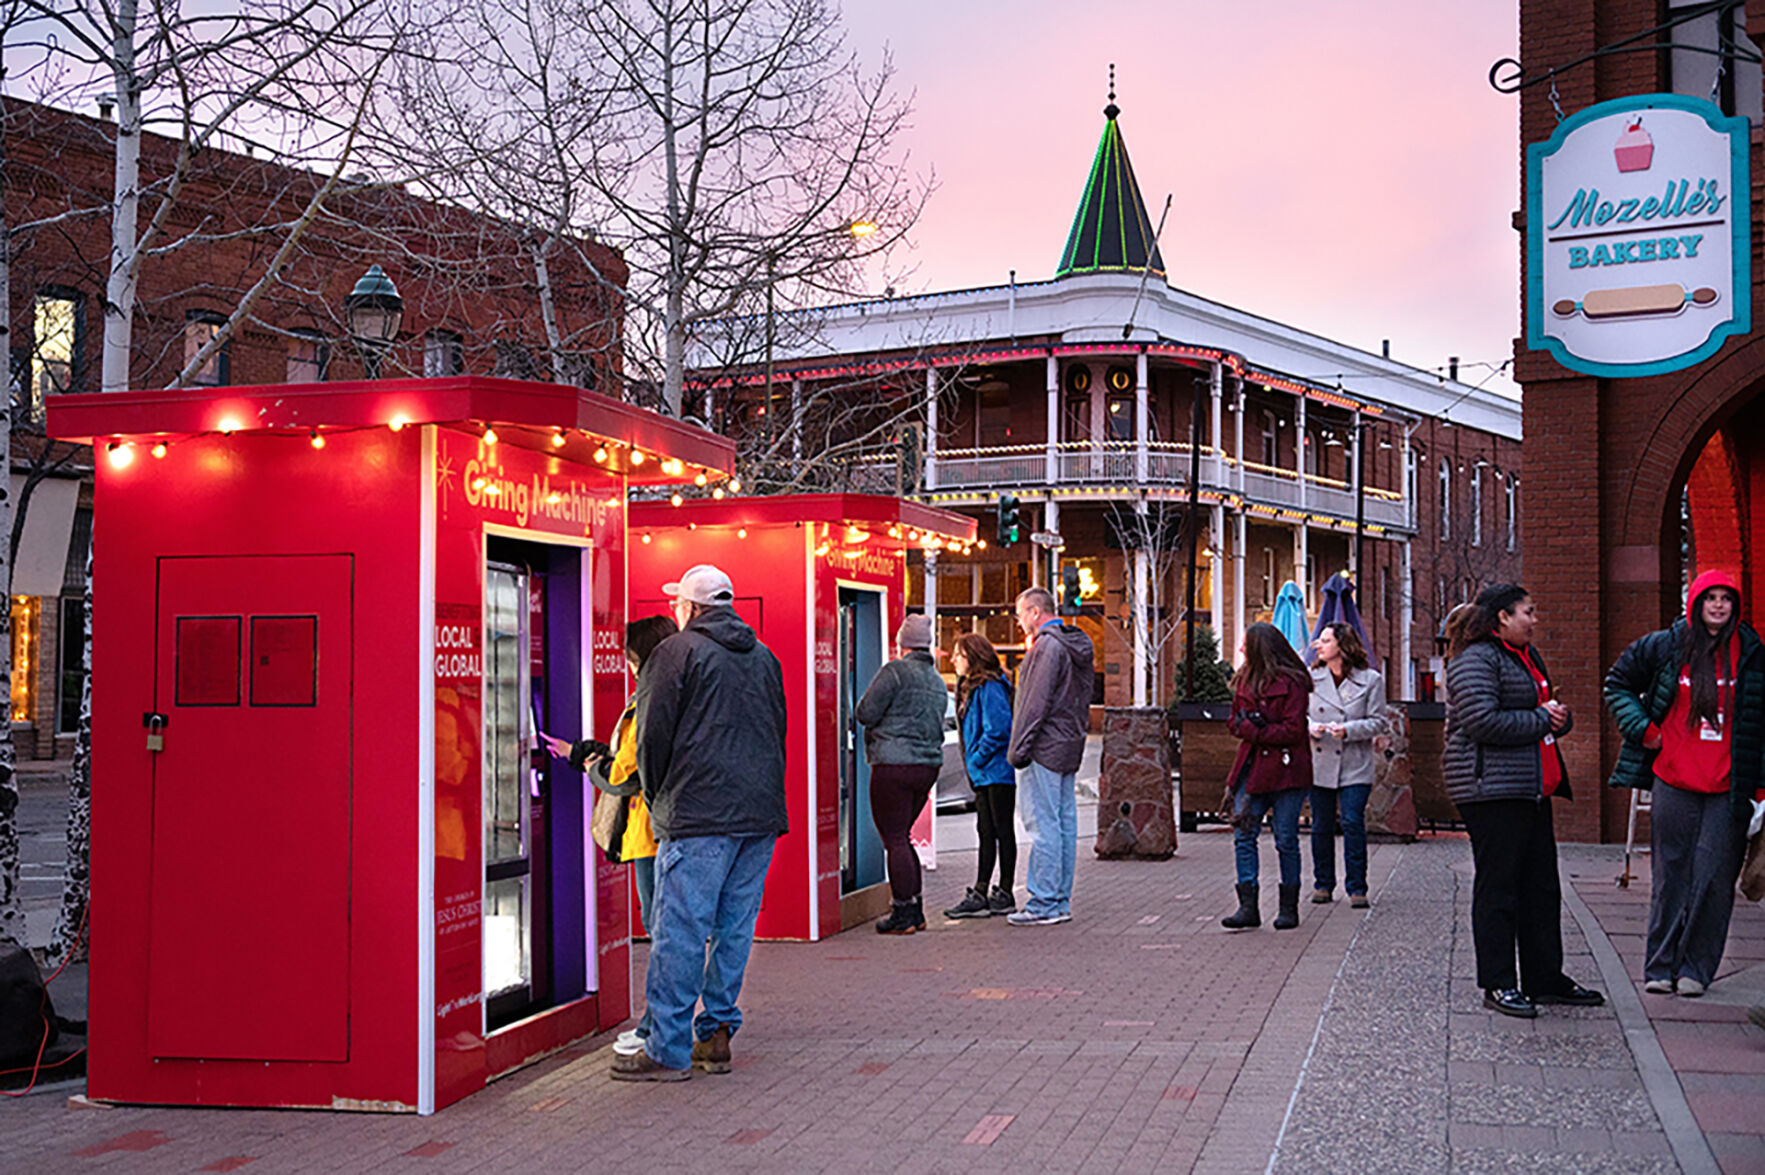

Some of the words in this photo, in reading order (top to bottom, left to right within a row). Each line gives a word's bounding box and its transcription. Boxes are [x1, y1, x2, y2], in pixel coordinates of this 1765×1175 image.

[1547, 177, 1727, 231] Mozelle's
[1568, 235, 1704, 269] BAKERY
[464, 460, 529, 527] Giving
[532, 473, 607, 526] Machine
[435, 626, 473, 648] LOCAL
[593, 630, 620, 649] LOCAL
[435, 654, 482, 677] GLOBAL
[594, 655, 626, 674] GLOBAL
